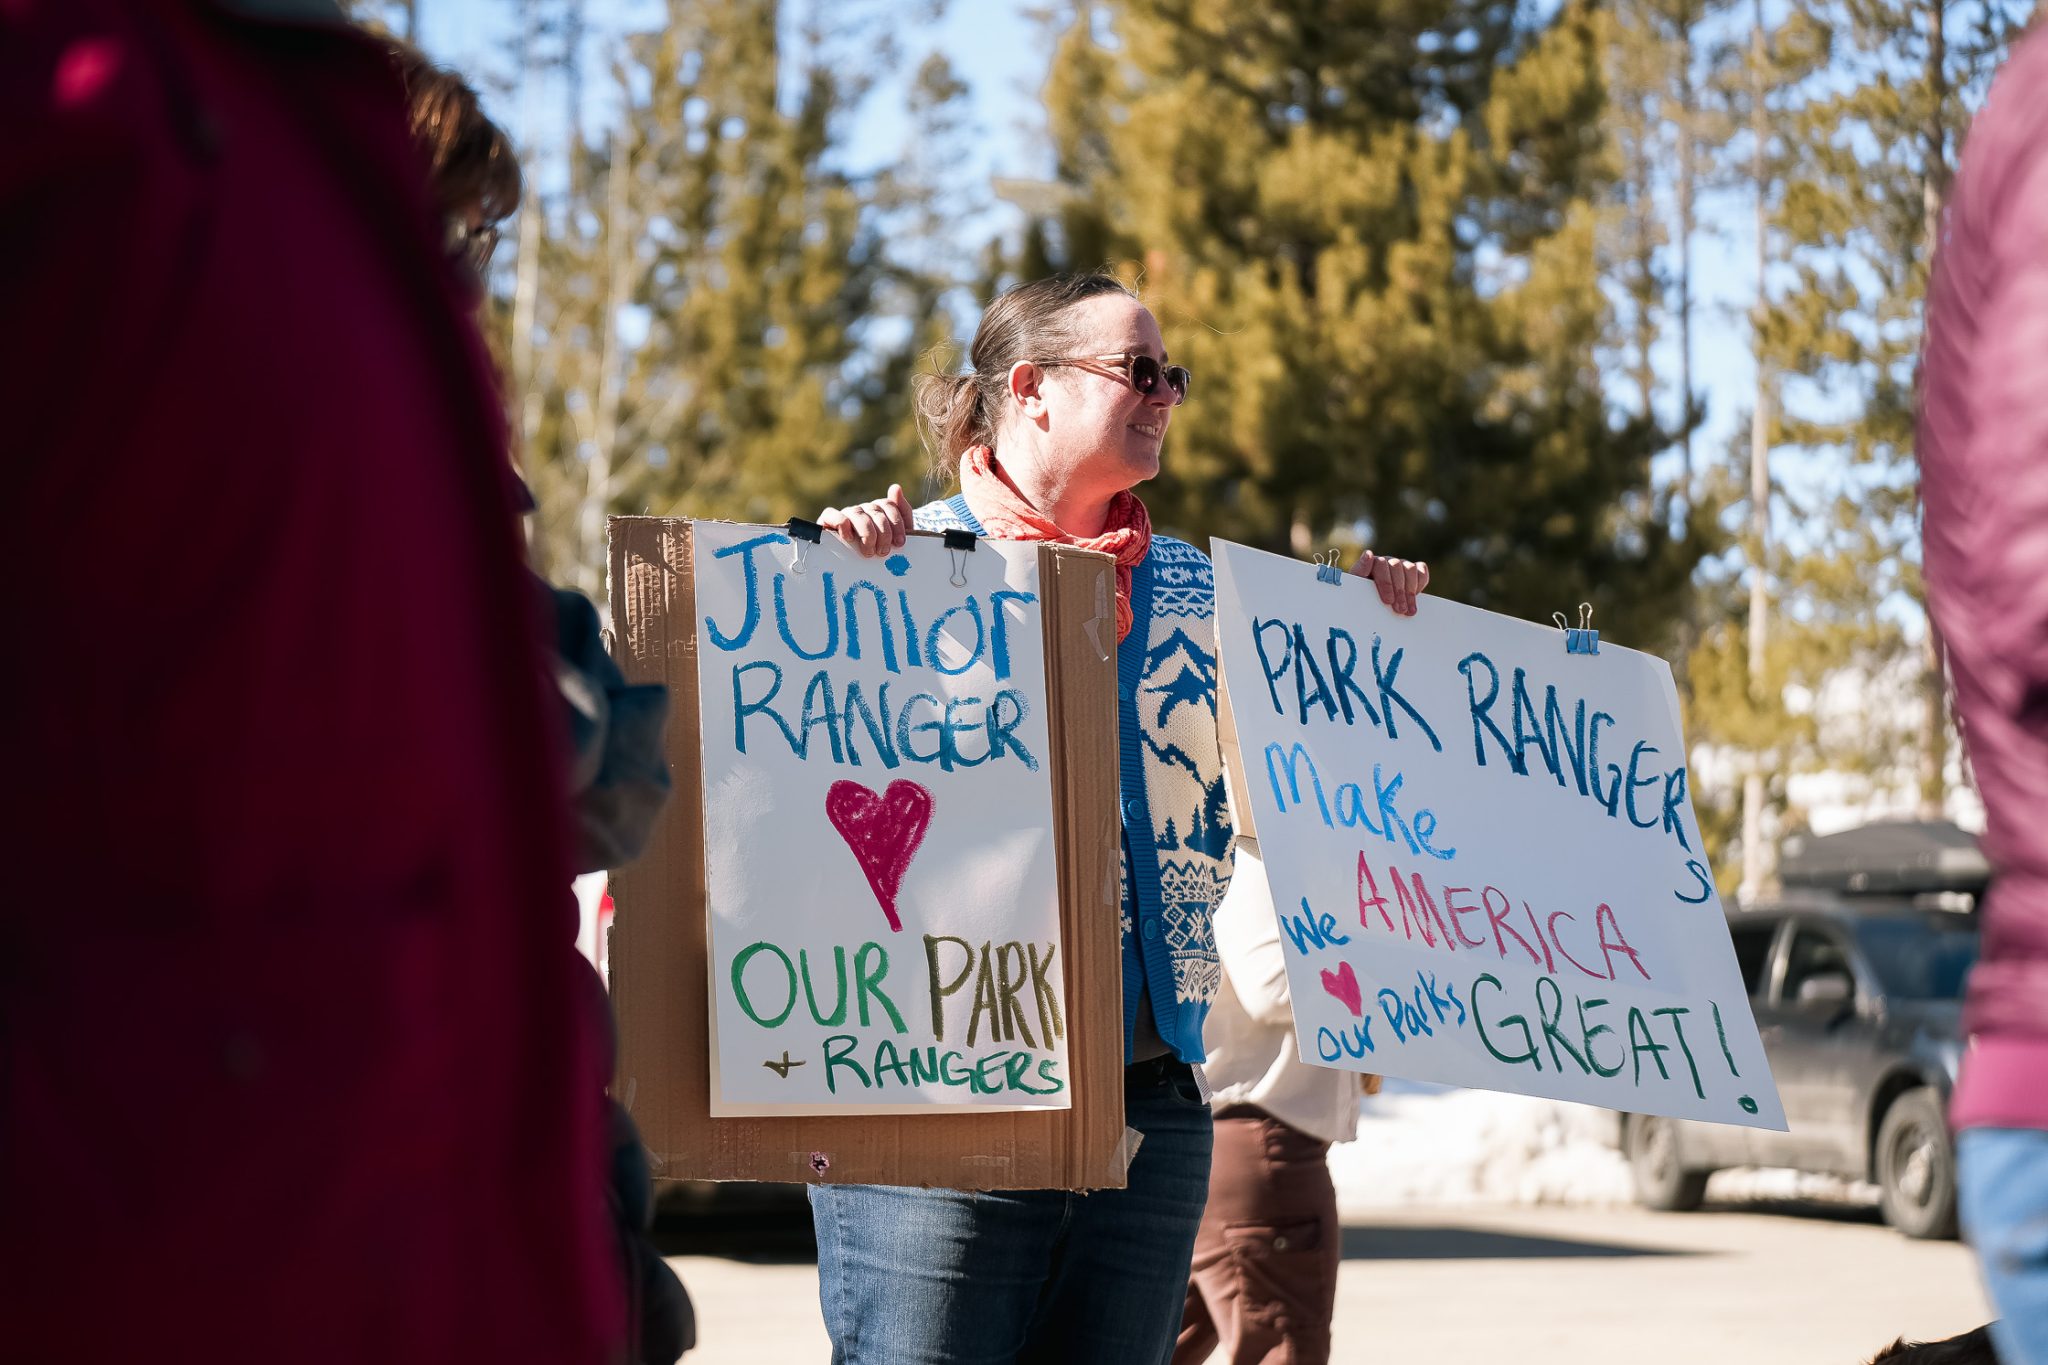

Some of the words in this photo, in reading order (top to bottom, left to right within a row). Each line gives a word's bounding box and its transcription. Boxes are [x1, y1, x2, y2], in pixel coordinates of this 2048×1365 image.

[732, 660, 1039, 773] RANGER
[1252, 616, 1443, 753] PARK
[1281, 897, 1350, 956] We
[1357, 850, 1652, 982] AMERICA
[731, 940, 909, 1034] OUR
[922, 933, 1065, 1051] PARK
[1317, 1014, 1376, 1062] our
[1471, 973, 1760, 1114] GREAT!
[823, 1034, 1066, 1096] RANGERS
